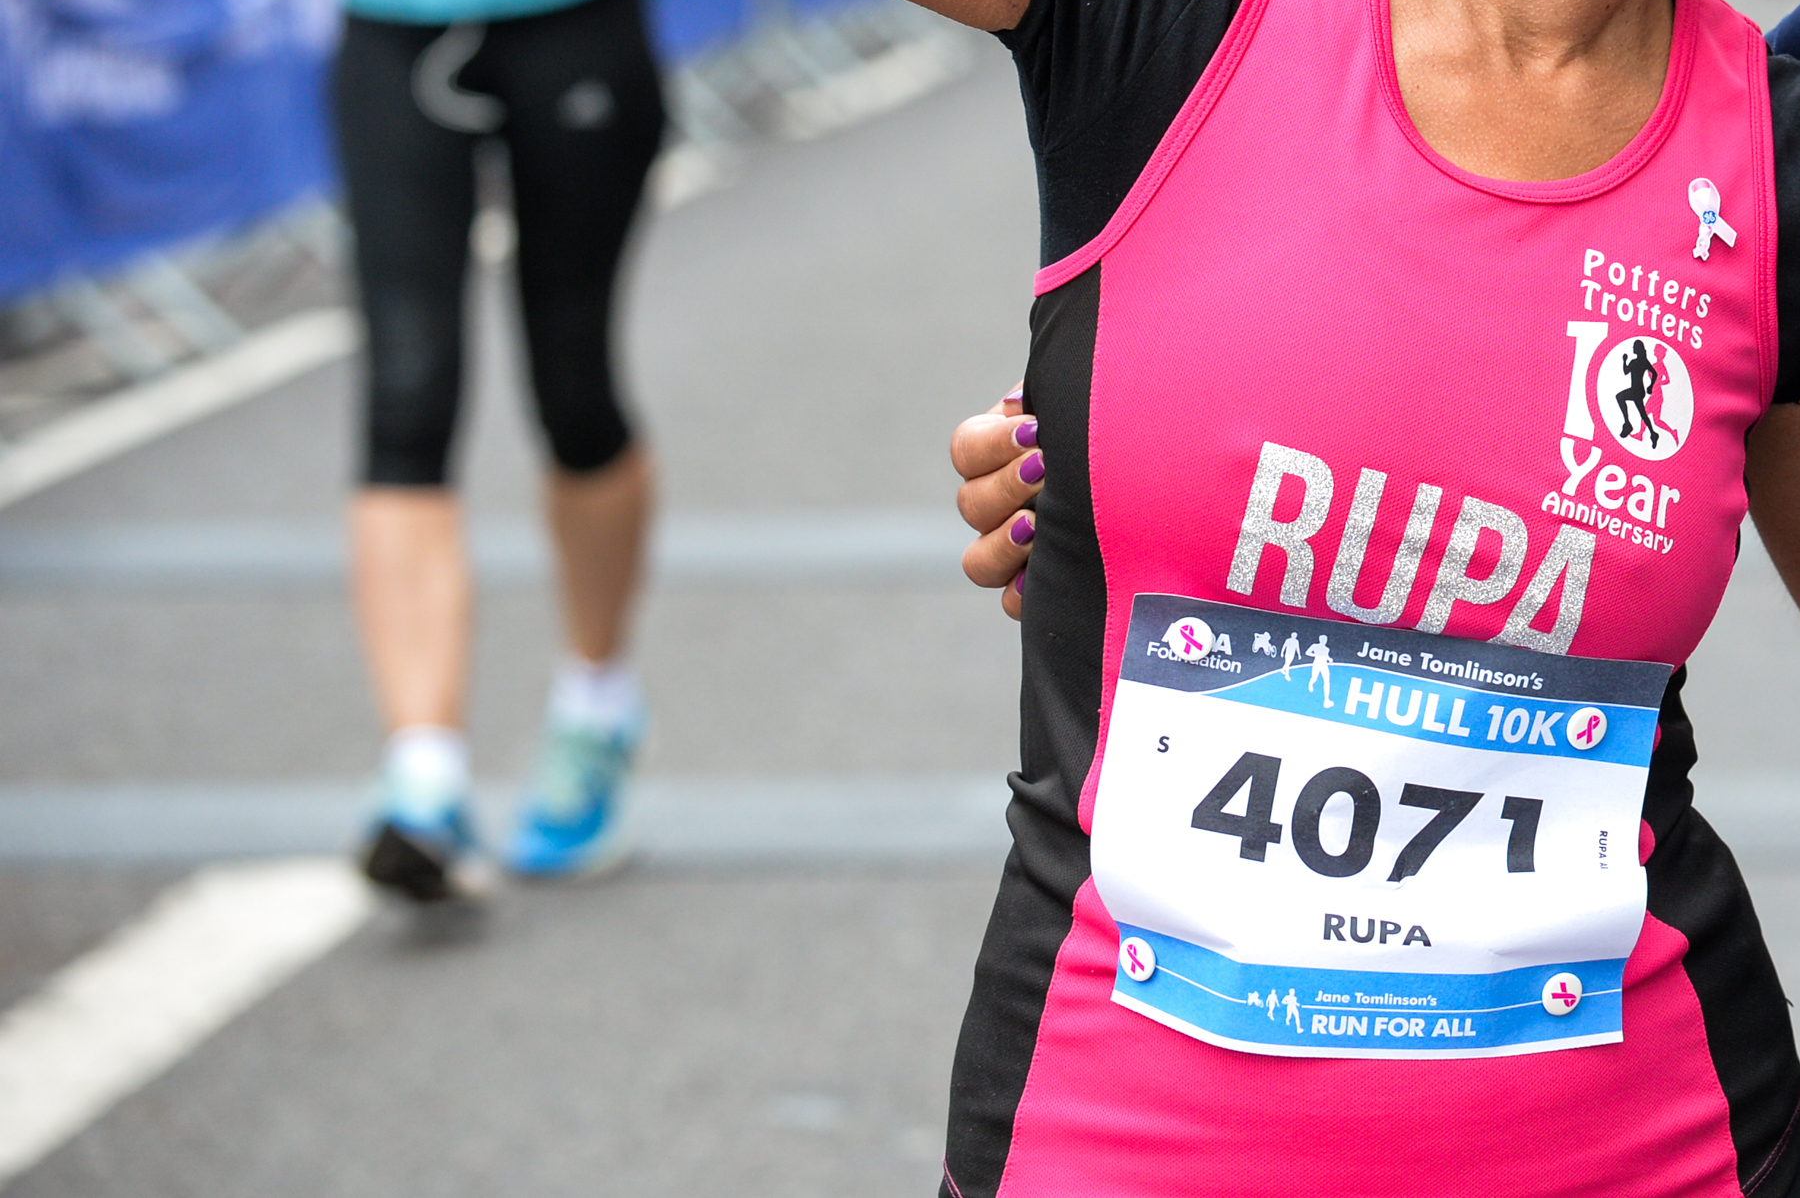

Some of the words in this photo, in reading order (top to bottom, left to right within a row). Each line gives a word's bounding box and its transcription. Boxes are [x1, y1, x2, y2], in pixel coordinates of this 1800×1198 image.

[1580, 279, 1703, 349] Trotters
[1584, 248, 1711, 318] Potters
[1563, 320, 1694, 461] 10
[1560, 437, 1680, 529] Year
[1226, 441, 1597, 655] RUPA
[1541, 491, 1673, 554] Anniversary
[1146, 641, 1242, 674] Fouation
[1357, 642, 1412, 666] Jane
[1420, 652, 1544, 690] Tomlinson's
[1344, 677, 1471, 737] HULL
[1486, 705, 1564, 747] 10K
[1157, 735, 1170, 754] S
[1190, 751, 1544, 883] 4071
[1598, 830, 1608, 859] RUPA
[1323, 913, 1431, 947] RUPA
[1312, 1014, 1368, 1036] RUN
[1374, 1017, 1425, 1037] FOR
[1431, 1018, 1477, 1037] ALL
[1315, 990, 1350, 1003] Jane
[1355, 992, 1437, 1006] Tomlinson's
